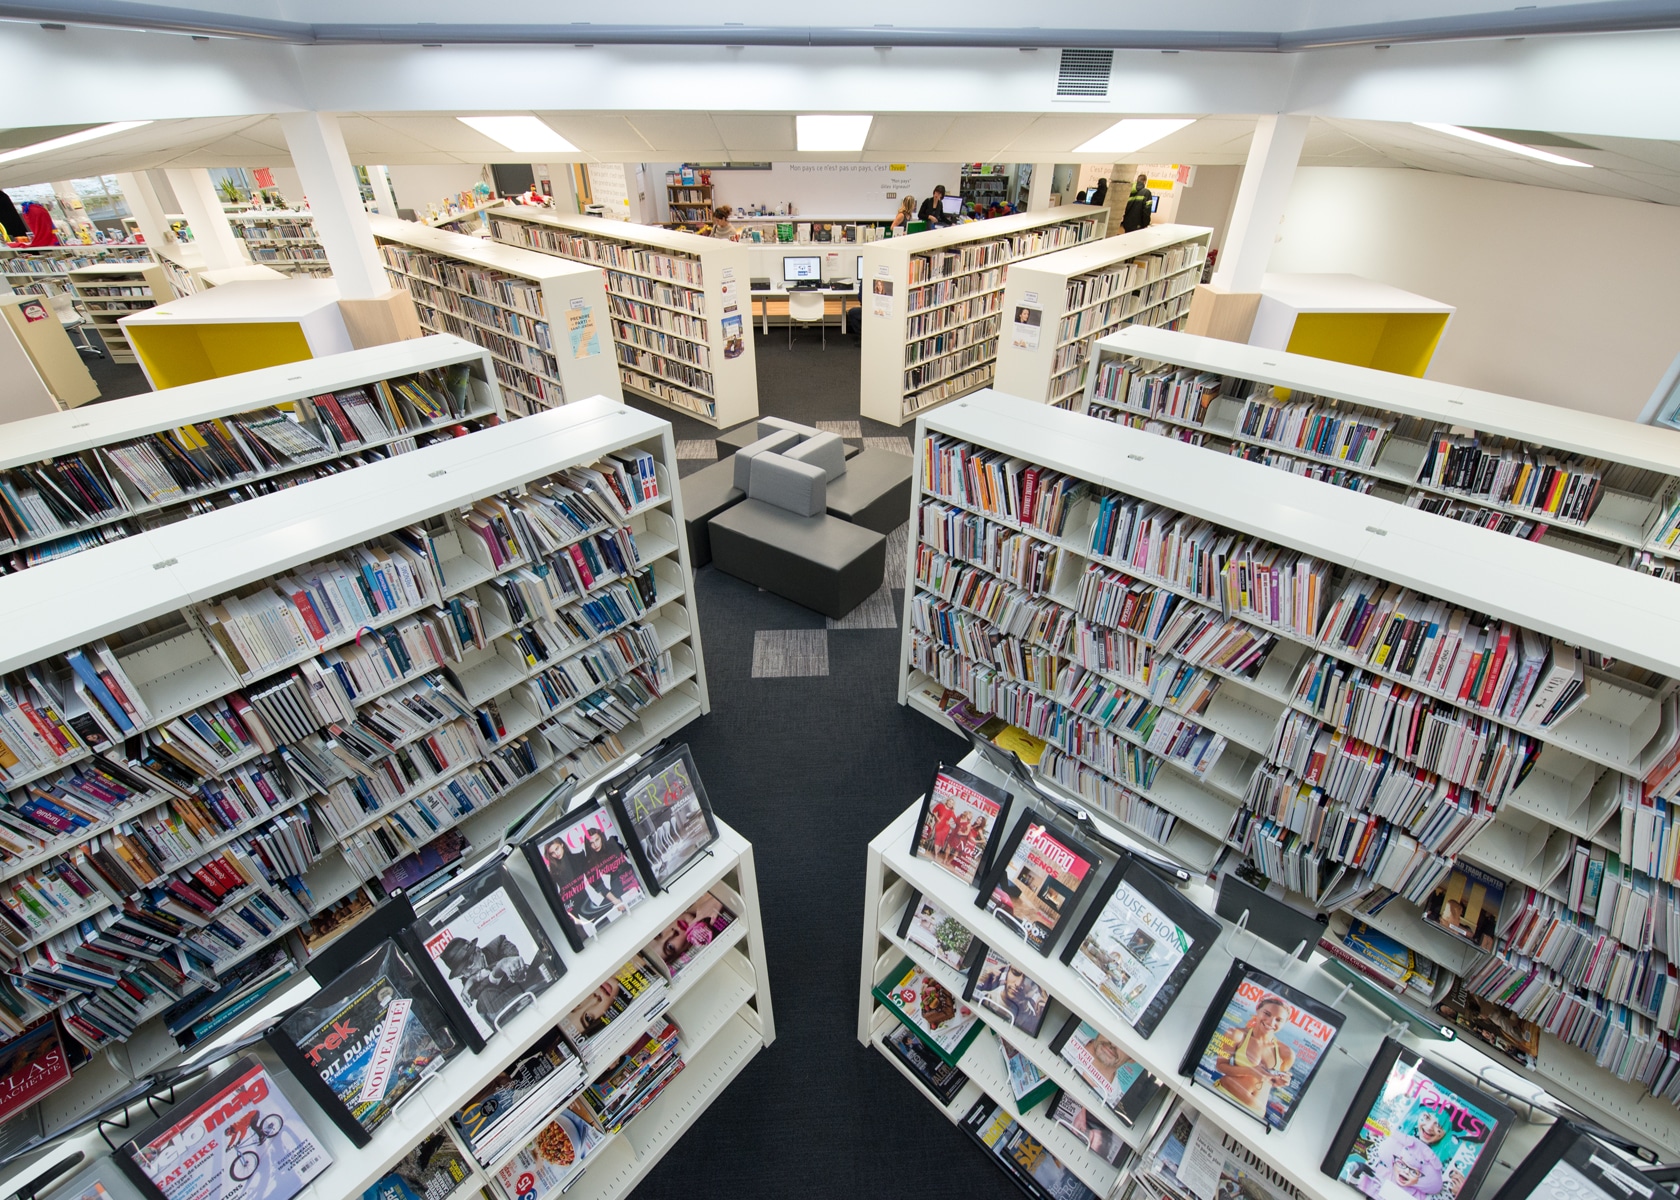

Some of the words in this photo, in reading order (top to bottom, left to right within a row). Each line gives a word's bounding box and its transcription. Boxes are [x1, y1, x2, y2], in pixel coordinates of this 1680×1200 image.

[634, 764, 688, 822] ARTS
[35, 807, 61, 826] Turquie
[956, 840, 982, 859] Noël
[1027, 853, 1058, 879] RÉNOS
[55, 891, 71, 907] Maroc
[464, 890, 504, 922] LEONARD
[472, 902, 504, 926] COHEN
[1116, 888, 1146, 916] OUSE
[1142, 912, 1152, 925] &
[1150, 917, 1183, 954] HOME
[903, 990, 914, 1001] 15
[344, 1041, 362, 1063] DU
[1078, 1053, 1088, 1066] NOS
[1088, 1065, 1113, 1093] ERREURS
[203, 1077, 270, 1133] mag
[1222, 1133, 1241, 1156] LE
[157, 1166, 182, 1192] FAT
[185, 1139, 219, 1171] BIKE
[516, 1175, 533, 1192] 15
